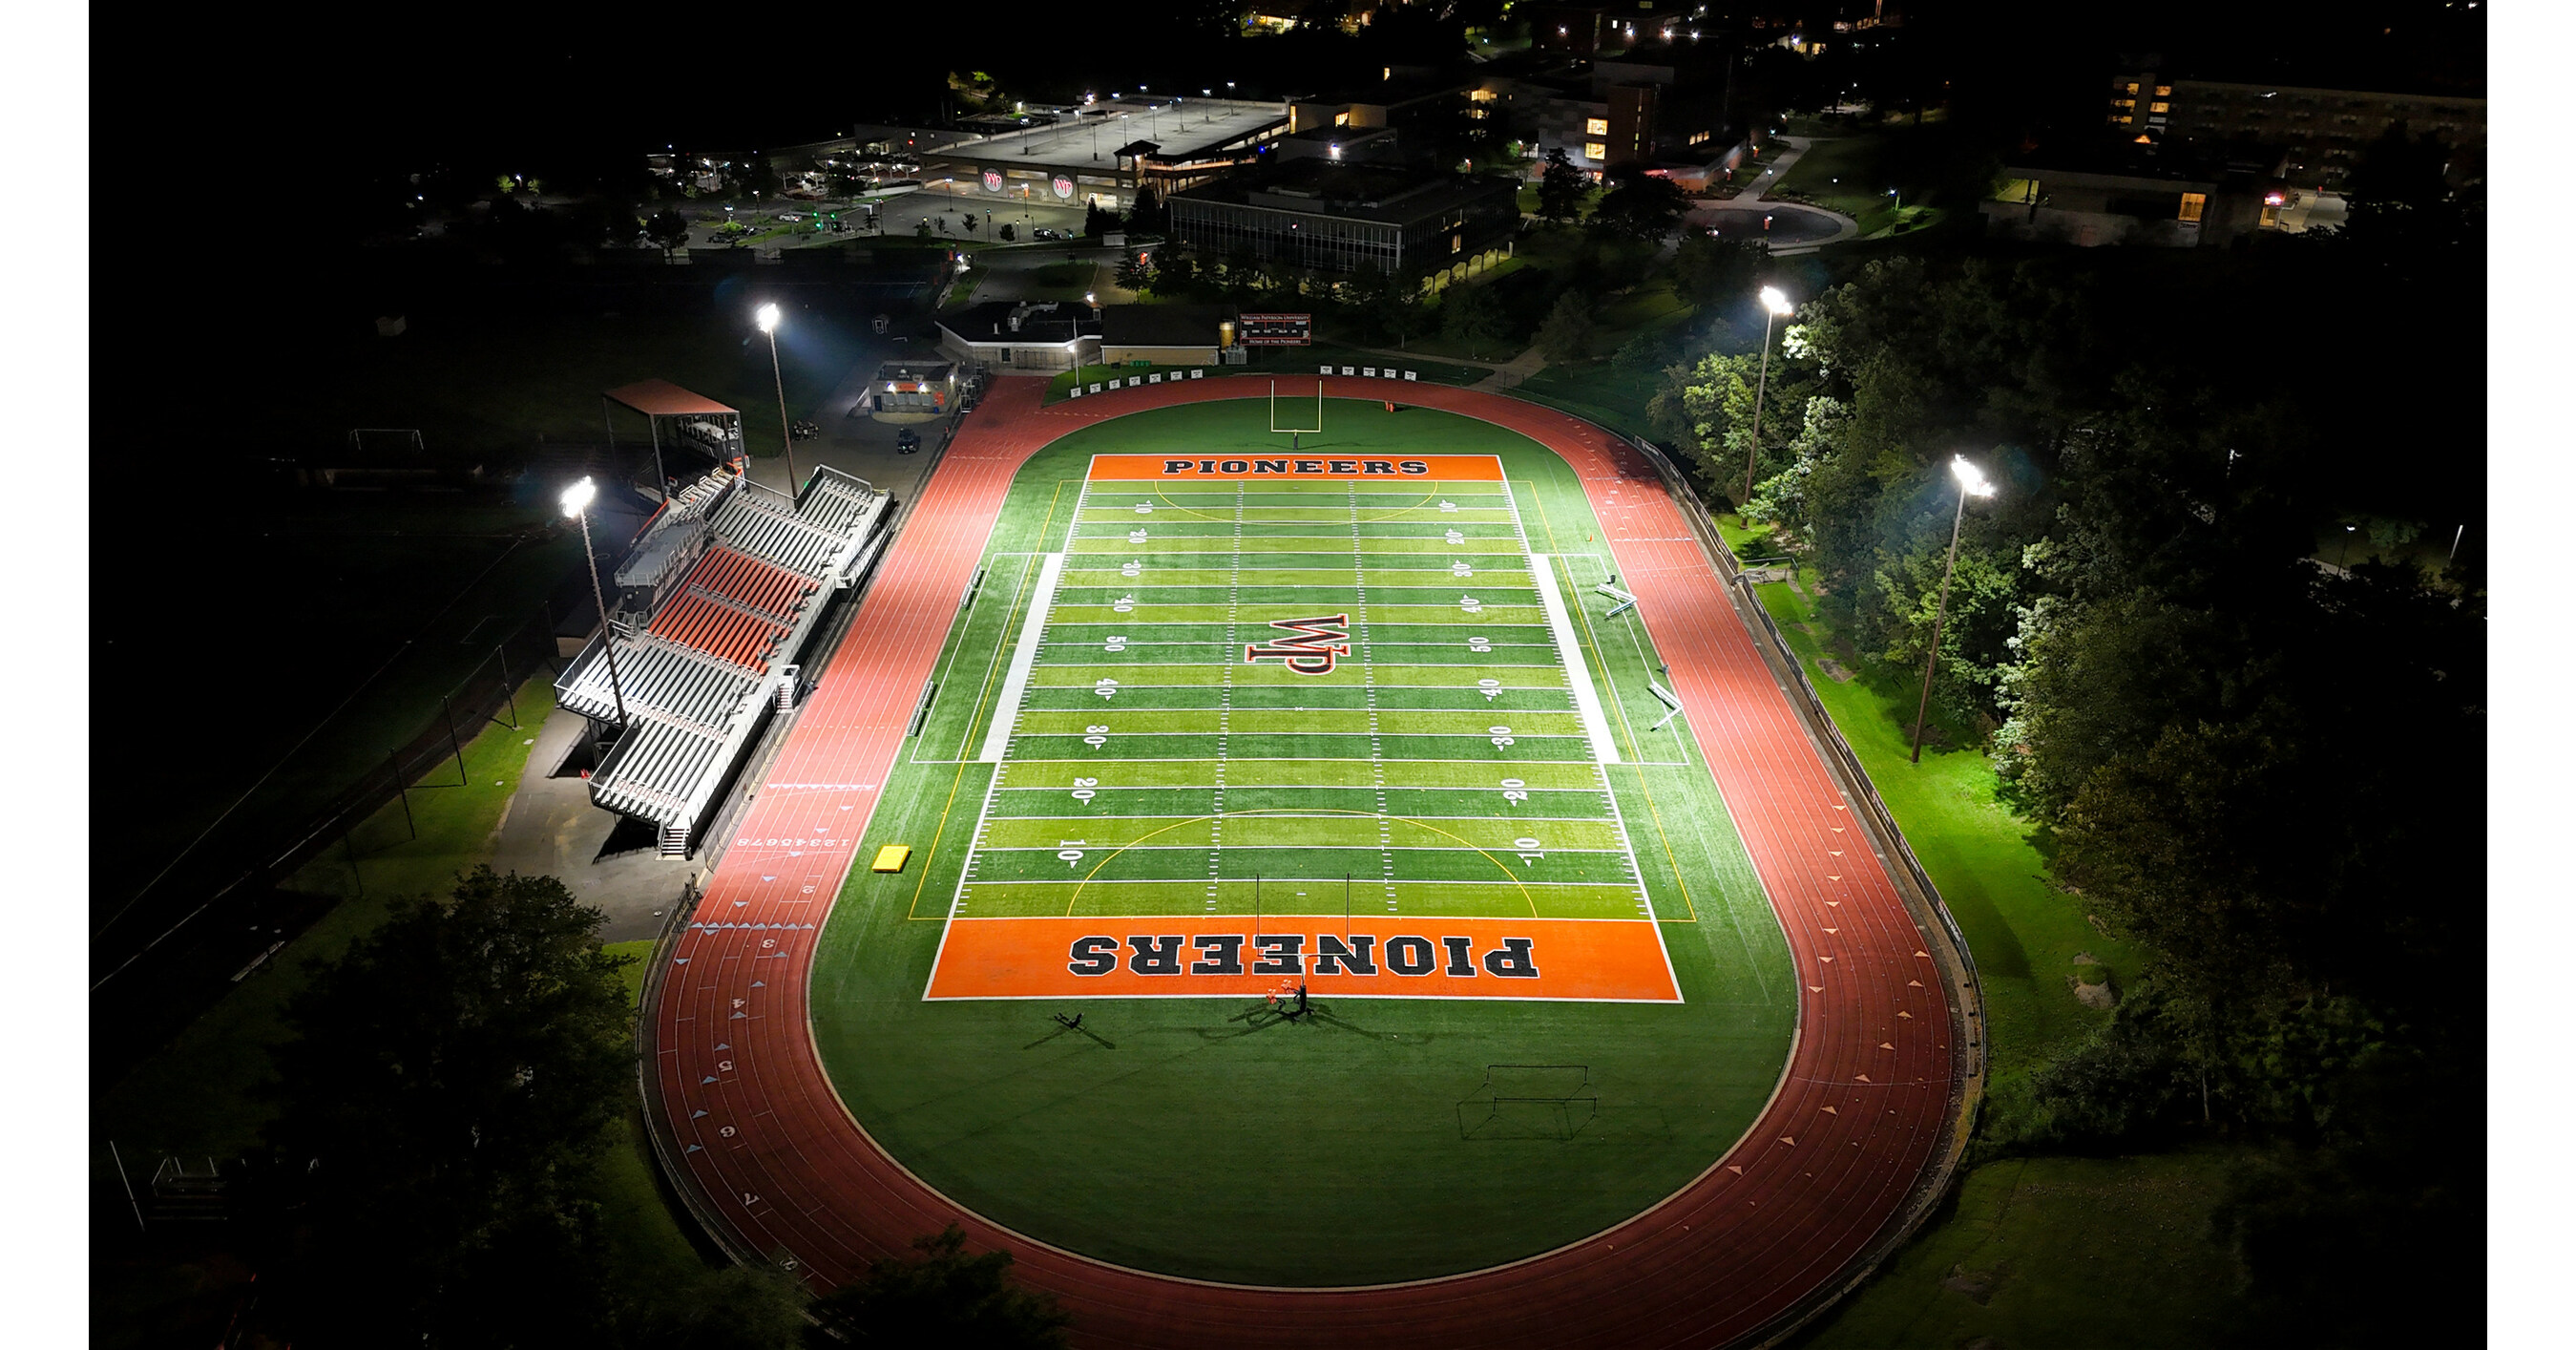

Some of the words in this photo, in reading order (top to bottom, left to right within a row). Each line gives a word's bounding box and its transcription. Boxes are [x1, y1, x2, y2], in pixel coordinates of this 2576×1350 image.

[1162, 459, 1429, 476] PIONEERS
[1134, 503, 1153, 514] 10
[1438, 502, 1458, 513] 10
[1128, 531, 1147, 543] 20
[1445, 532, 1465, 544] 20
[1120, 562, 1141, 577] 30
[1452, 563, 1474, 578] 30
[1113, 598, 1135, 612] 40
[1459, 598, 1482, 613] 40
[1104, 636, 1127, 651] 50
[1244, 613, 1351, 676] WP
[1468, 637, 1492, 652] 50
[1094, 678, 1119, 696] 40
[1477, 679, 1503, 697] 40
[1083, 726, 1109, 745] 30
[1488, 726, 1515, 746] 30
[1071, 777, 1099, 799] 20
[1500, 778, 1529, 801] 20
[1057, 839, 1086, 860] 10
[1514, 837, 1544, 859] 10
[762, 939, 775, 949] 3
[1066, 935, 1539, 979] PIONEERS
[732, 998, 745, 1008] 4
[718, 1060, 733, 1072] 5
[720, 1126, 736, 1138] 6
[743, 1192, 760, 1206] 7
